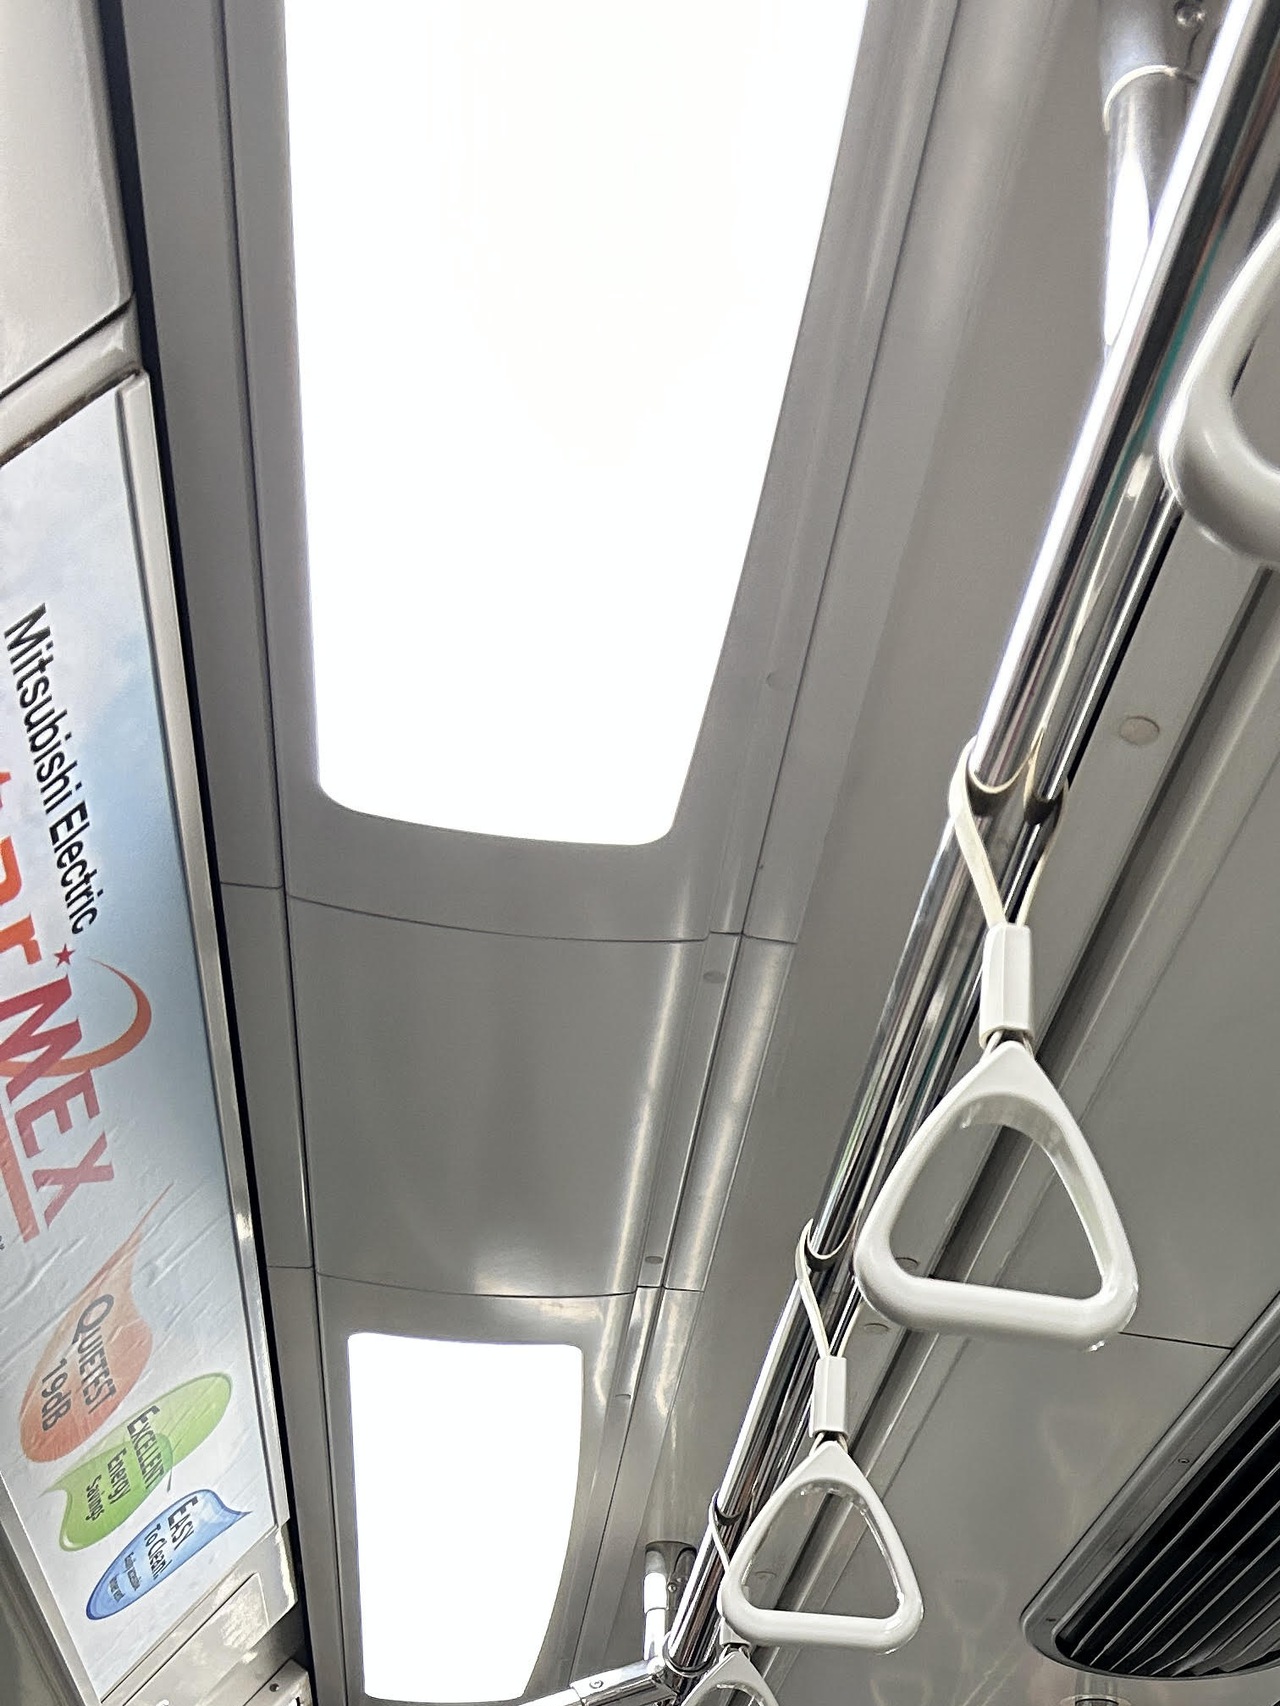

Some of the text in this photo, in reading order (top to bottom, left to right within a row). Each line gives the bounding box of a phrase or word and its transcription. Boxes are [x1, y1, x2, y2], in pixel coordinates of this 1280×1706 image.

[4, 602, 104, 935] Mitsubishi Electric
[72, 1294, 116, 1414] QUIETEST
[42, 1357, 72, 1431] 19dB
[108, 1448, 131, 1504] Energy
[127, 1405, 164, 1489] EXCELLENT
[85, 1474, 105, 1521] Savings
[168, 1496, 199, 1551] EASY
[144, 1523, 162, 1548] To
